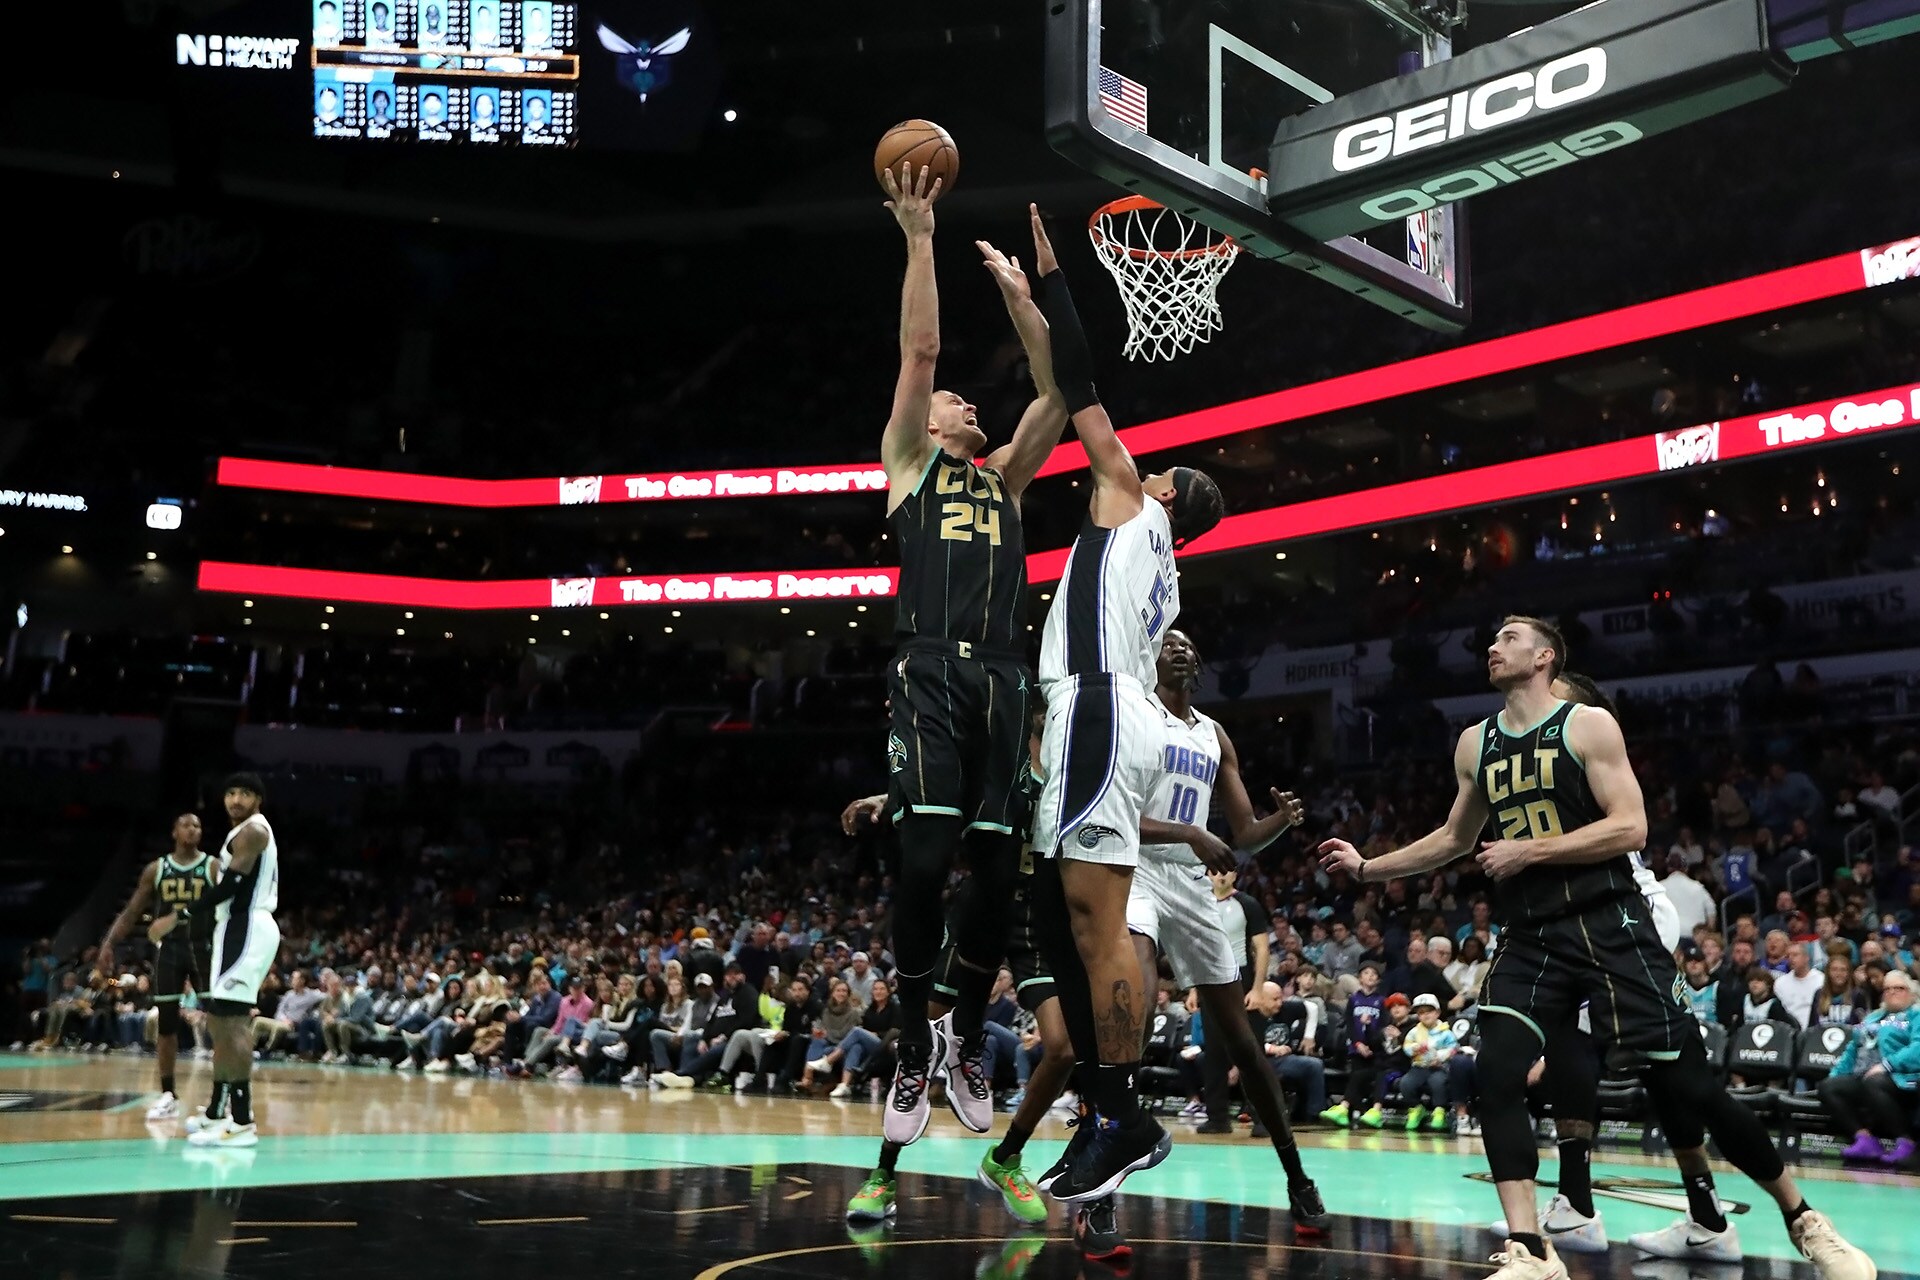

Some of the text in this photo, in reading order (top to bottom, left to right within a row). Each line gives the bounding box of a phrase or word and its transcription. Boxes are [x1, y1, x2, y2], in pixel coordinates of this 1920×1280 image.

[225, 36, 300, 55] NOVANT
[225, 51, 292, 70] HEALTH
[1332, 47, 1607, 172] GEICO
[1360, 121, 1643, 220] GEICO
[1758, 413, 1826, 446] The
[1830, 399, 1905, 434] One
[625, 477, 666, 498] The
[668, 475, 712, 497] One
[715, 473, 773, 495] Fans
[777, 470, 887, 493] Deserve
[936, 460, 1003, 503] CLT
[940, 502, 1001, 545] 24
[619, 580, 662, 601] The
[664, 578, 711, 600] One
[713, 576, 773, 598] Fans
[777, 574, 891, 597] Deserve
[1141, 570, 1168, 641] 5
[1286, 657, 1359, 685] HORNETS
[1485, 748, 1558, 804] CLT
[1168, 782, 1198, 825] 10
[1498, 799, 1563, 840] 20
[160, 878, 205, 902] CLT
